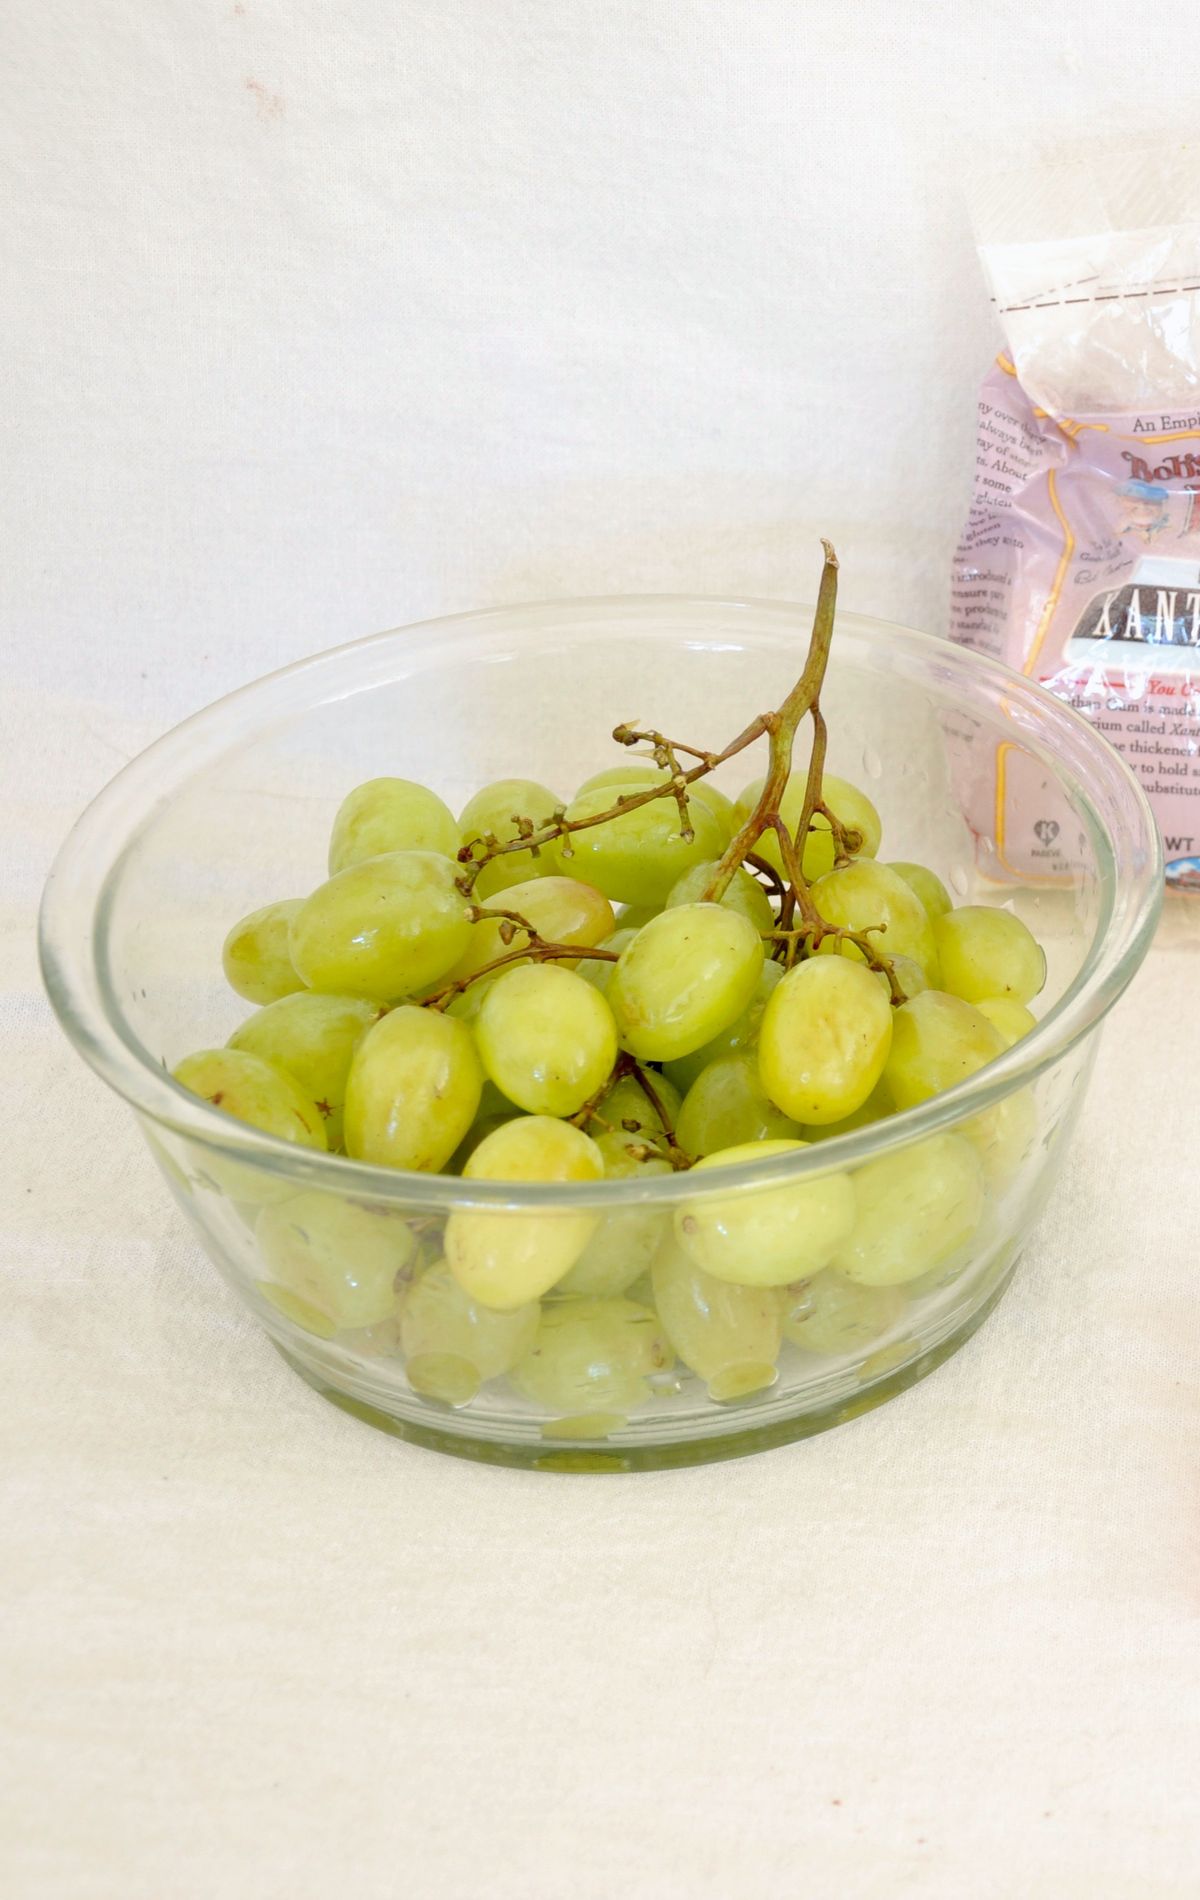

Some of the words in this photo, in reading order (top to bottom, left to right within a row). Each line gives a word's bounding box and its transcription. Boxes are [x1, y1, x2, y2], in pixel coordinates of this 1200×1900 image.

[995, 409, 1020, 425] over
[1133, 417, 1155, 433] An
[980, 421, 1018, 444] always
[996, 446, 1011, 457] of
[991, 459, 1028, 481] About
[983, 476, 1013, 493] some
[1147, 680, 1177, 696] You
[1106, 697, 1140, 714] Gum
[1143, 700, 1155, 714] is
[1158, 703, 1196, 717] made
[1126, 721, 1166, 736] called
[1129, 741, 1194, 757] thickener
[1141, 763, 1155, 775] to
[1158, 763, 1189, 777] hold
[1164, 835, 1195, 852] WT
